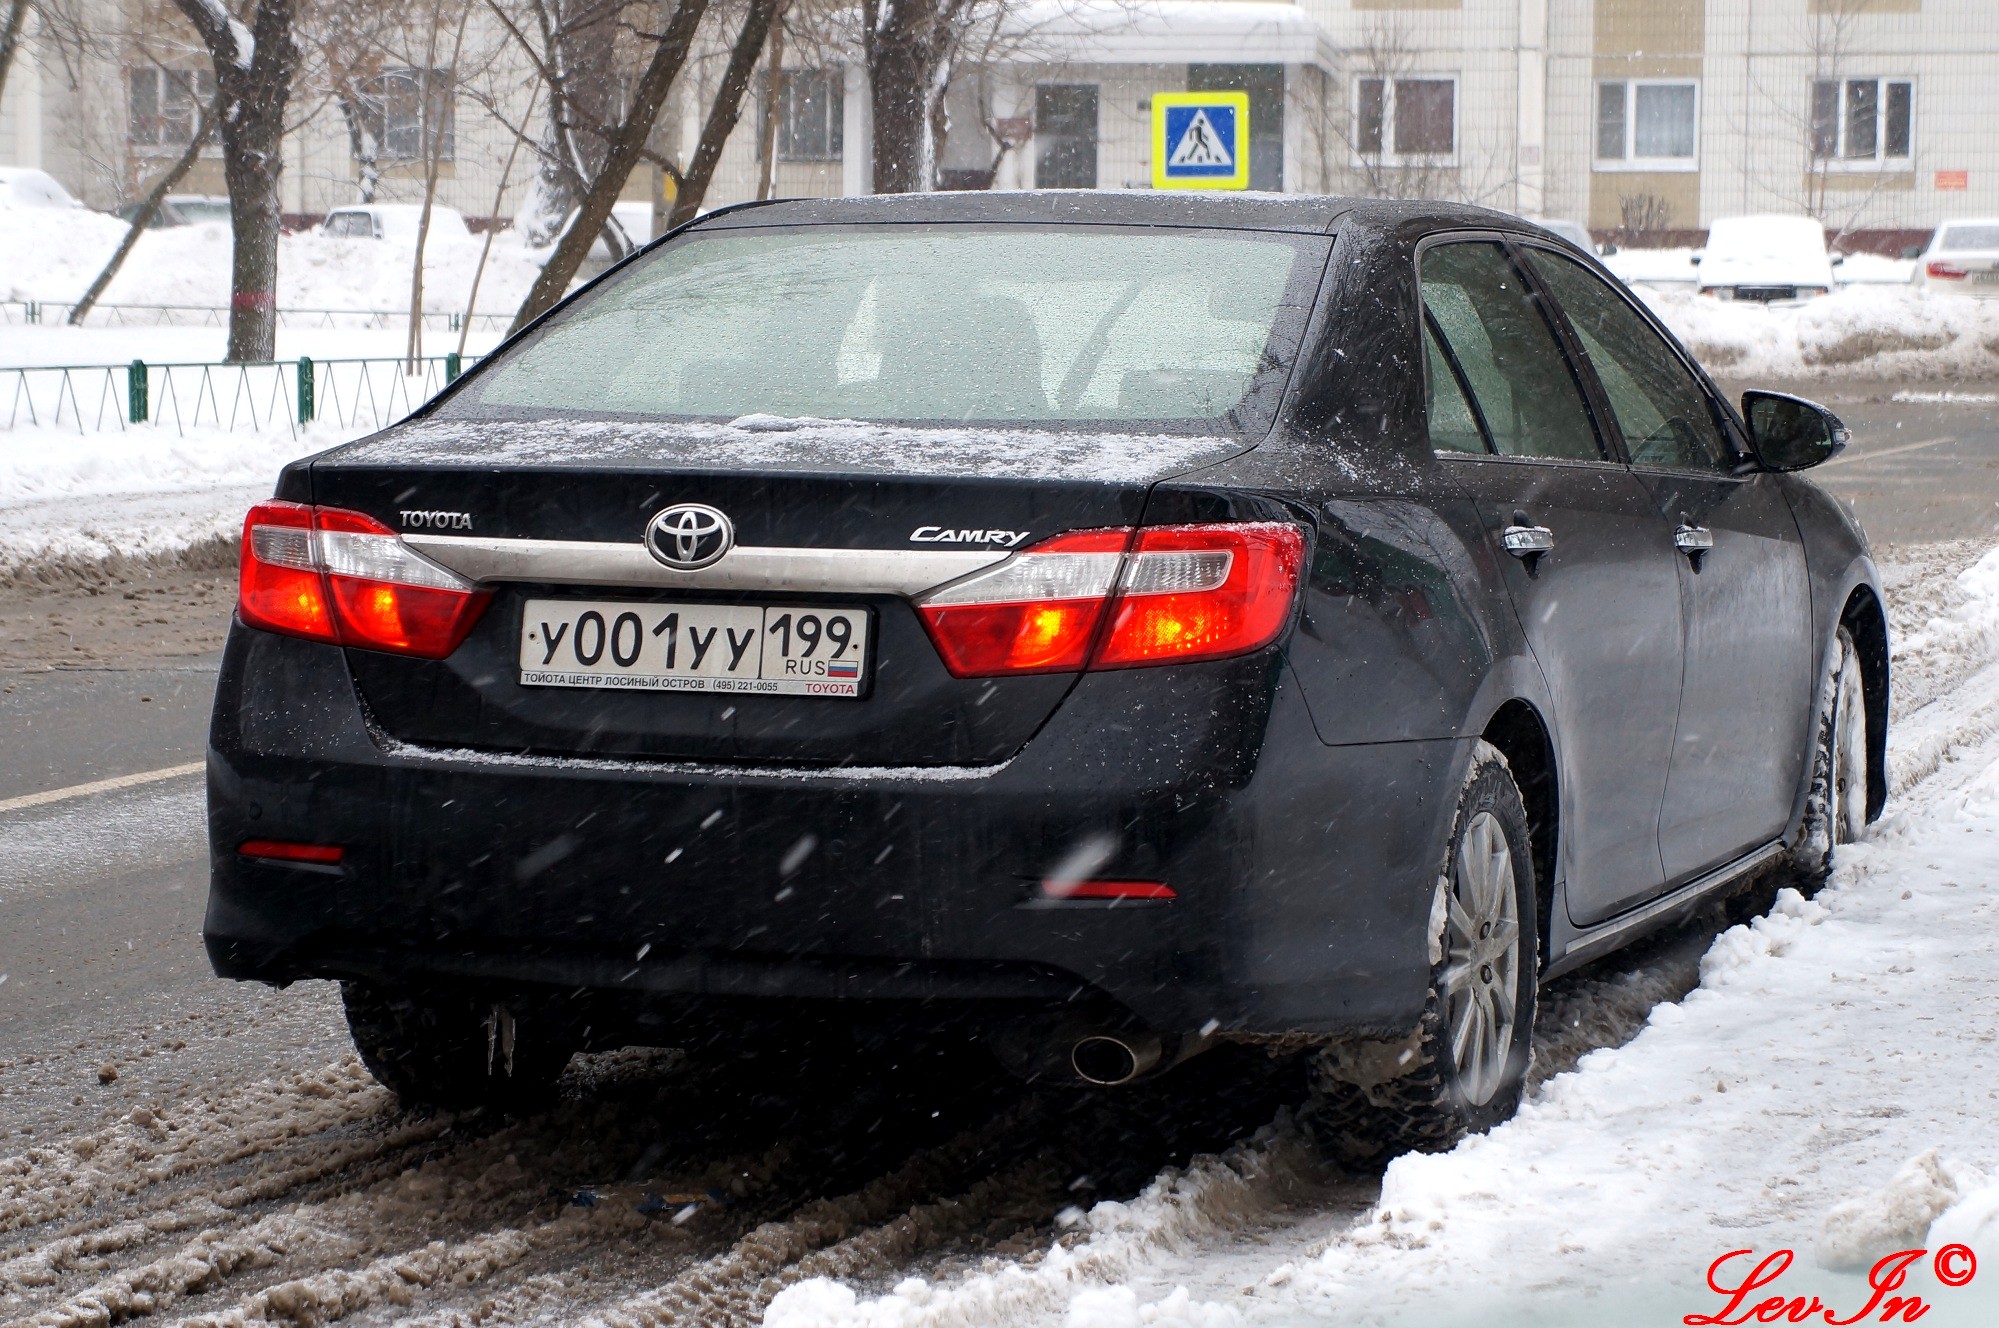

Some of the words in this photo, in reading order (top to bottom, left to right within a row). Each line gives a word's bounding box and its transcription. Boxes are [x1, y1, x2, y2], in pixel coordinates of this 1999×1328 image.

[400, 510, 473, 530] TOYOTA
[769, 613, 852, 659] 199
[785, 659, 826, 676] RUS
[524, 673, 566, 684] ТОЙОТА
[568, 676, 602, 686] ЦЕНТР
[604, 676, 659, 688] ЛОСИНЫЙ
[661, 679, 705, 689] ОСТРОВ
[712, 680, 736, 691] (495)
[737, 681, 778, 692] 221-0055
[805, 683, 855, 695] TOYOTA
